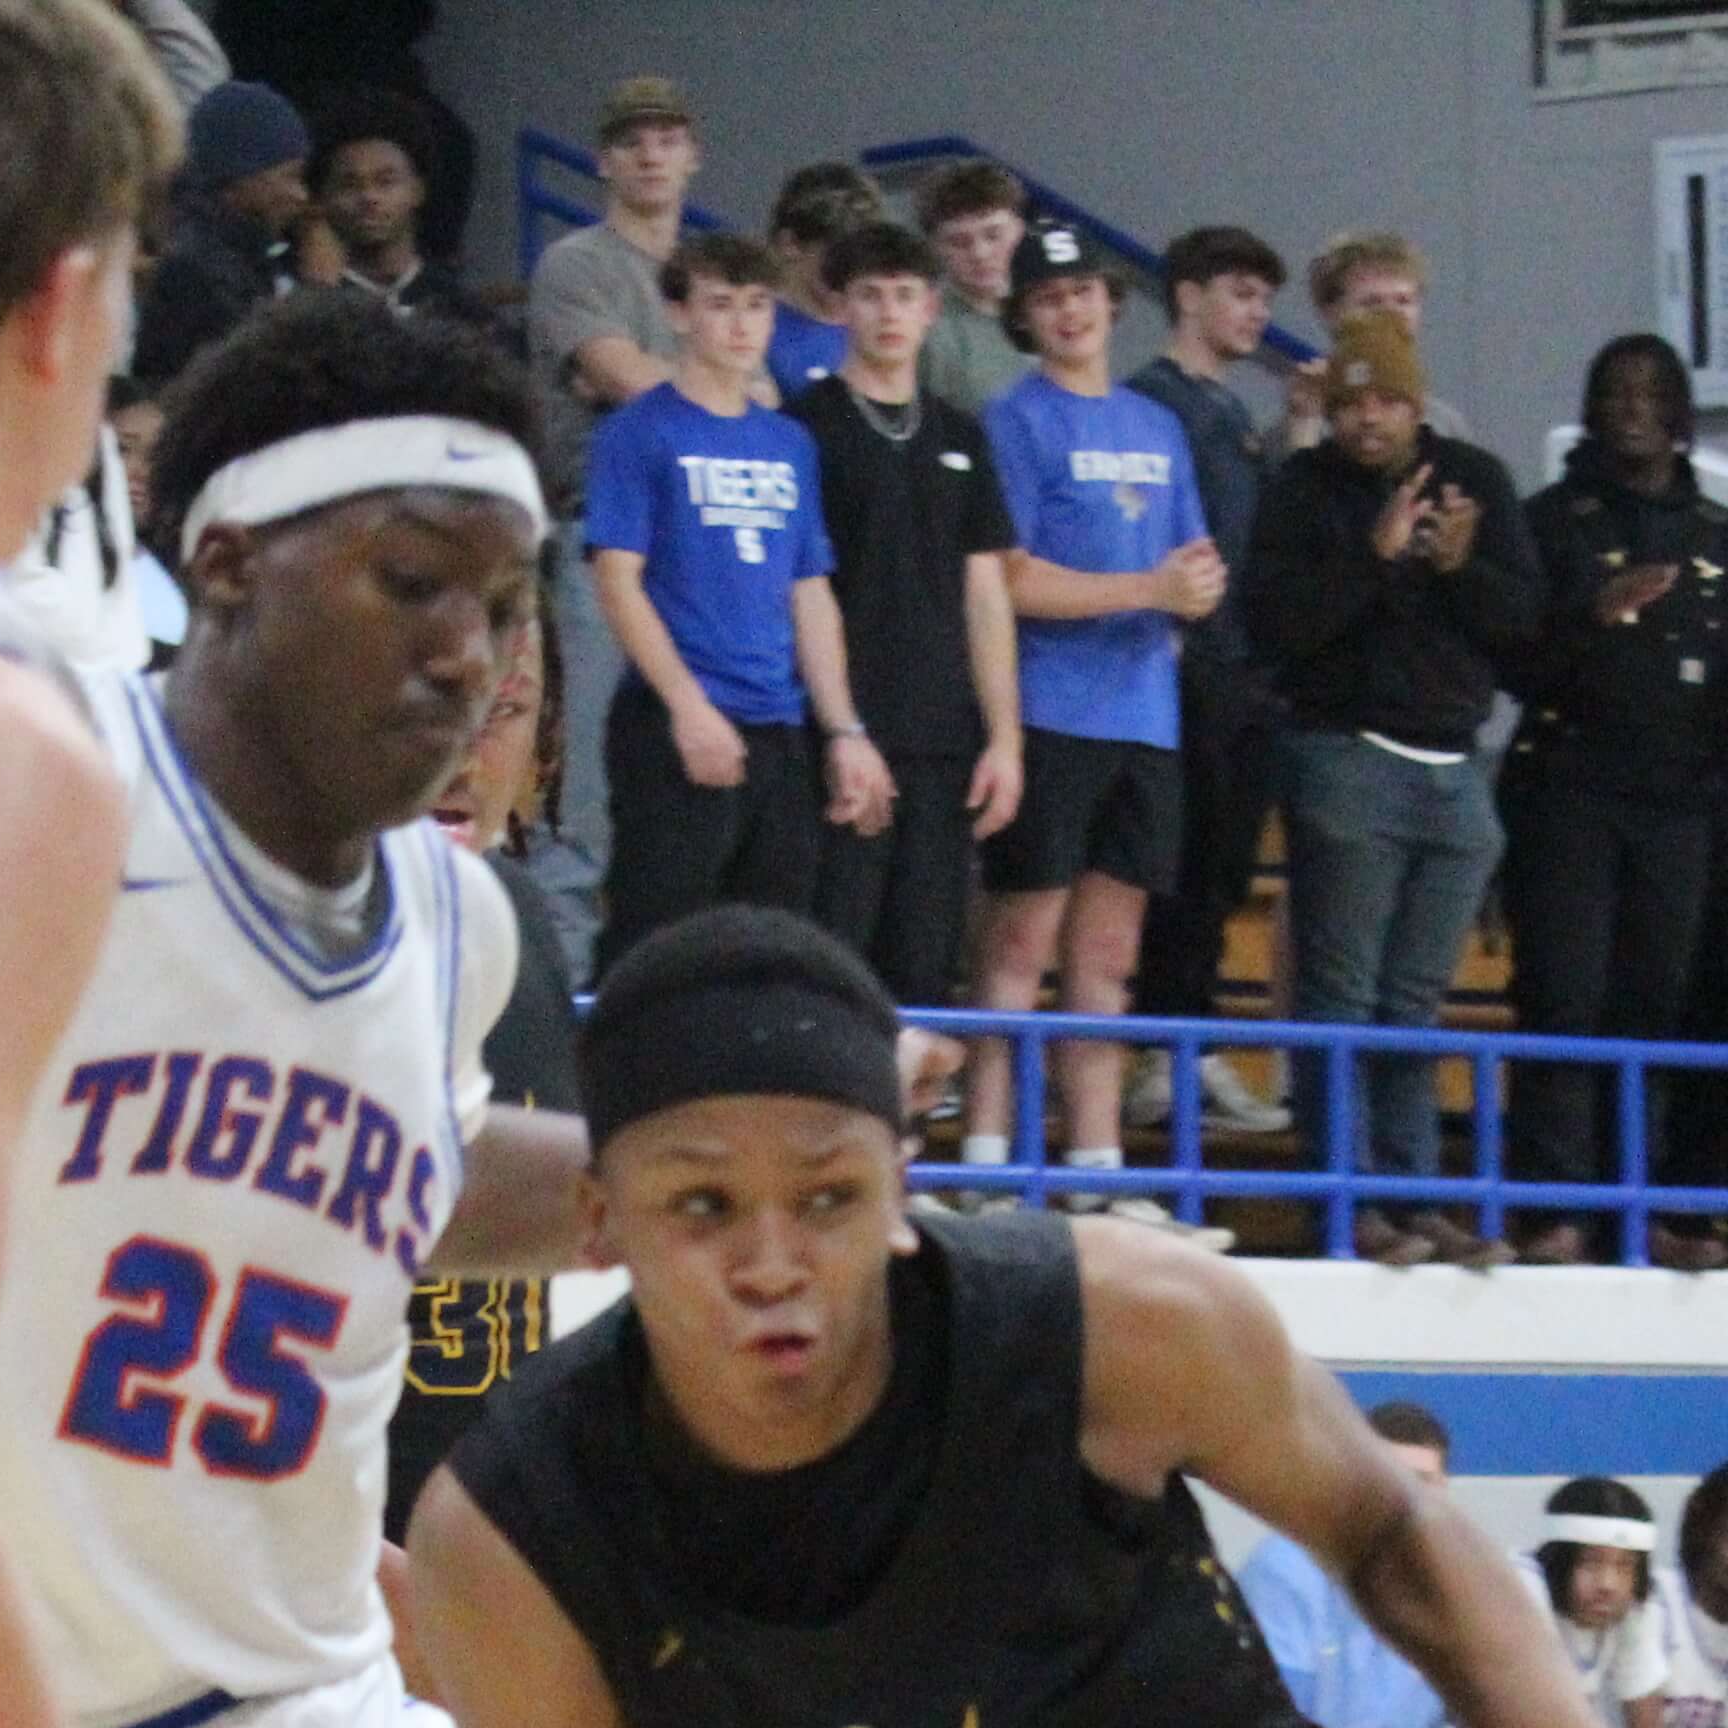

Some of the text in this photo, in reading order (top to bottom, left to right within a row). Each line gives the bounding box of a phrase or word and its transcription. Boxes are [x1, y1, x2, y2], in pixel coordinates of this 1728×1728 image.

[1042, 230, 1081, 263] S
[677, 456, 800, 511] TIGERS
[57, 1050, 438, 1278] TIGERS
[56, 1232, 352, 1484] 25
